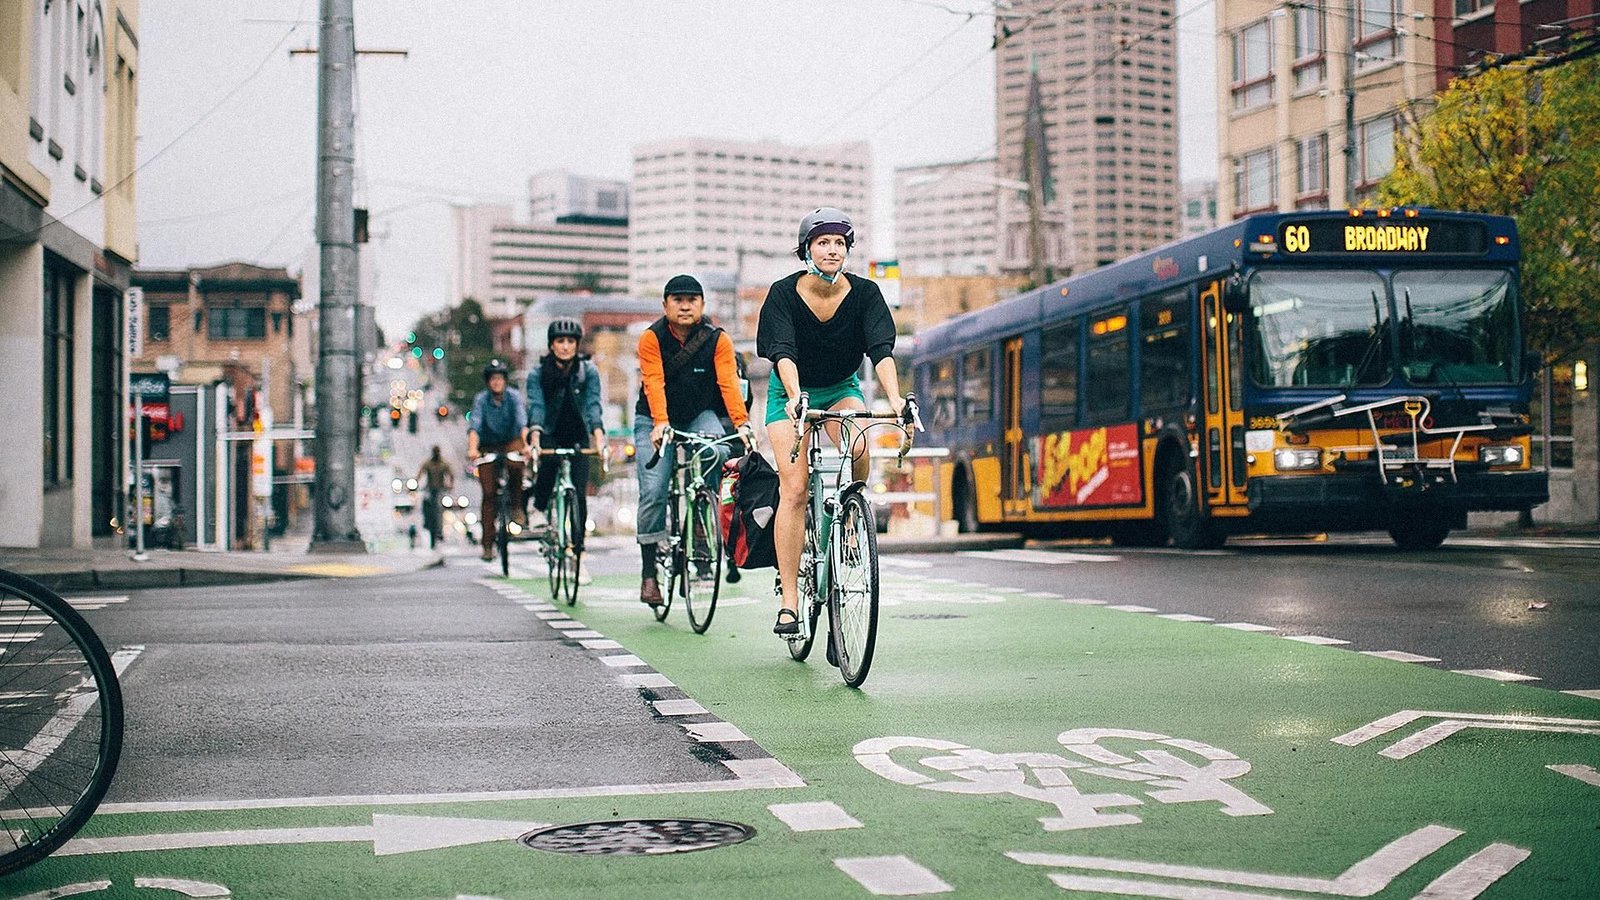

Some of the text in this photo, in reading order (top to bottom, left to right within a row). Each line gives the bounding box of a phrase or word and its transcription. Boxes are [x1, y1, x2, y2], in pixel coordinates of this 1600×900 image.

[1285, 225, 1429, 252] 60 BROADWAY
[1383, 415, 1434, 429] METO
